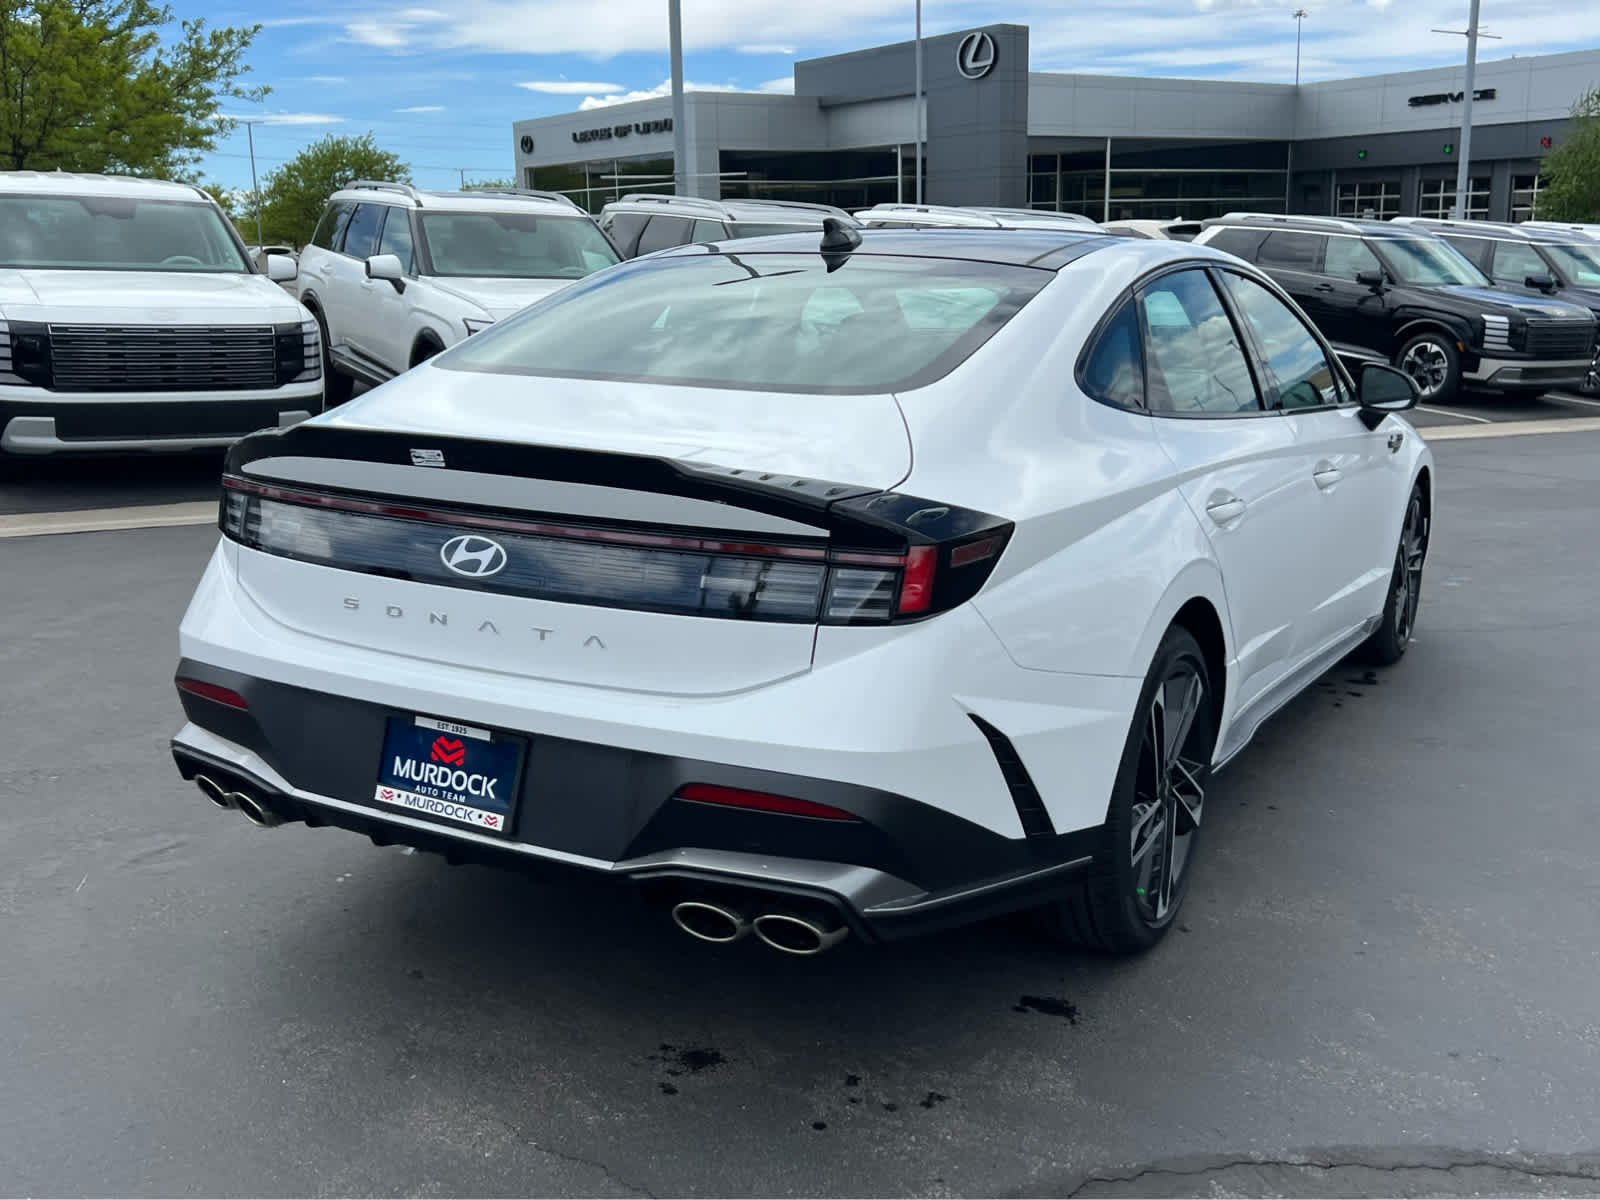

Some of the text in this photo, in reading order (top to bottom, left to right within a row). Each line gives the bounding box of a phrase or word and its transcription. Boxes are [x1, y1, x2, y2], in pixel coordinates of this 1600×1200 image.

[1407, 88, 1496, 107] SERVCE
[614, 124, 632, 138] OF
[634, 118, 673, 135] LINDO
[343, 597, 606, 649] SONATA
[451, 723, 468, 735] 1925
[392, 756, 498, 799] MURDOCK
[415, 784, 466, 803] AUTO TEAM
[404, 794, 475, 822] MURDOCK
